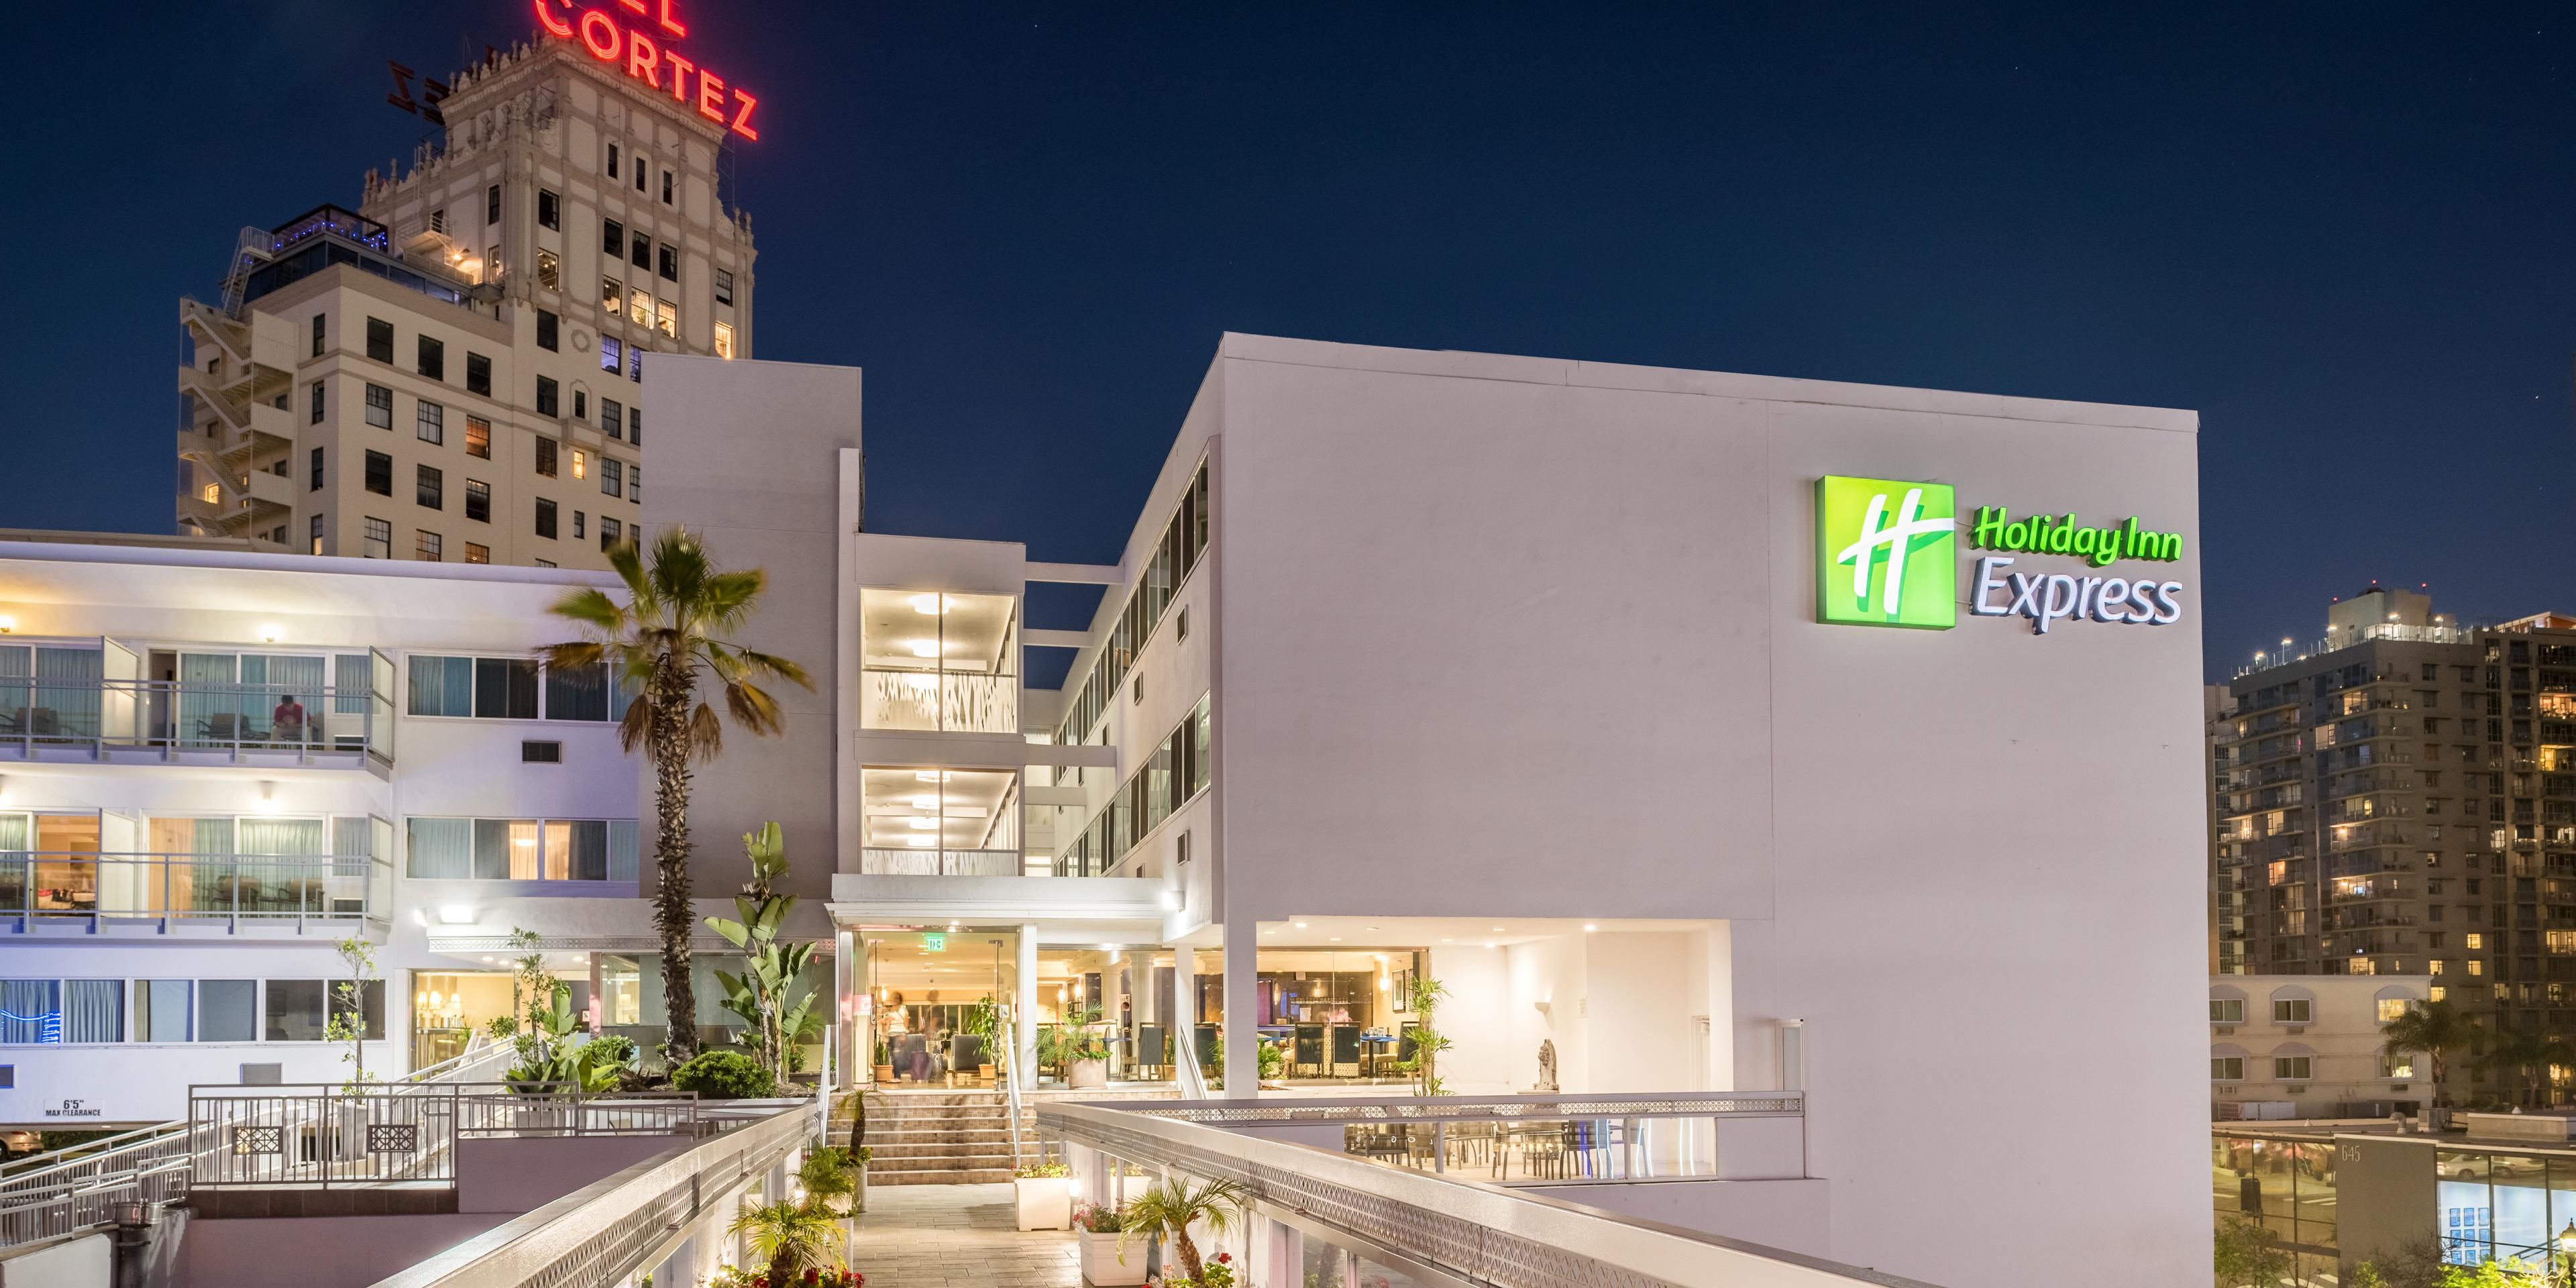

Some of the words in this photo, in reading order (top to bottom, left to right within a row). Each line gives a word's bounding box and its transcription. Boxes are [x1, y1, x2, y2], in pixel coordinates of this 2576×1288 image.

[620, 0, 685, 36] L
[536, 0, 757, 140] CORTEZ
[1973, 505, 2121, 566] Holiday
[2124, 515, 2184, 561] Inn
[1972, 556, 2183, 633] Express
[46, 1109, 61, 1117] MAX
[64, 1099, 85, 1110] 6'5"
[2342, 1144, 2361, 1162] 645
